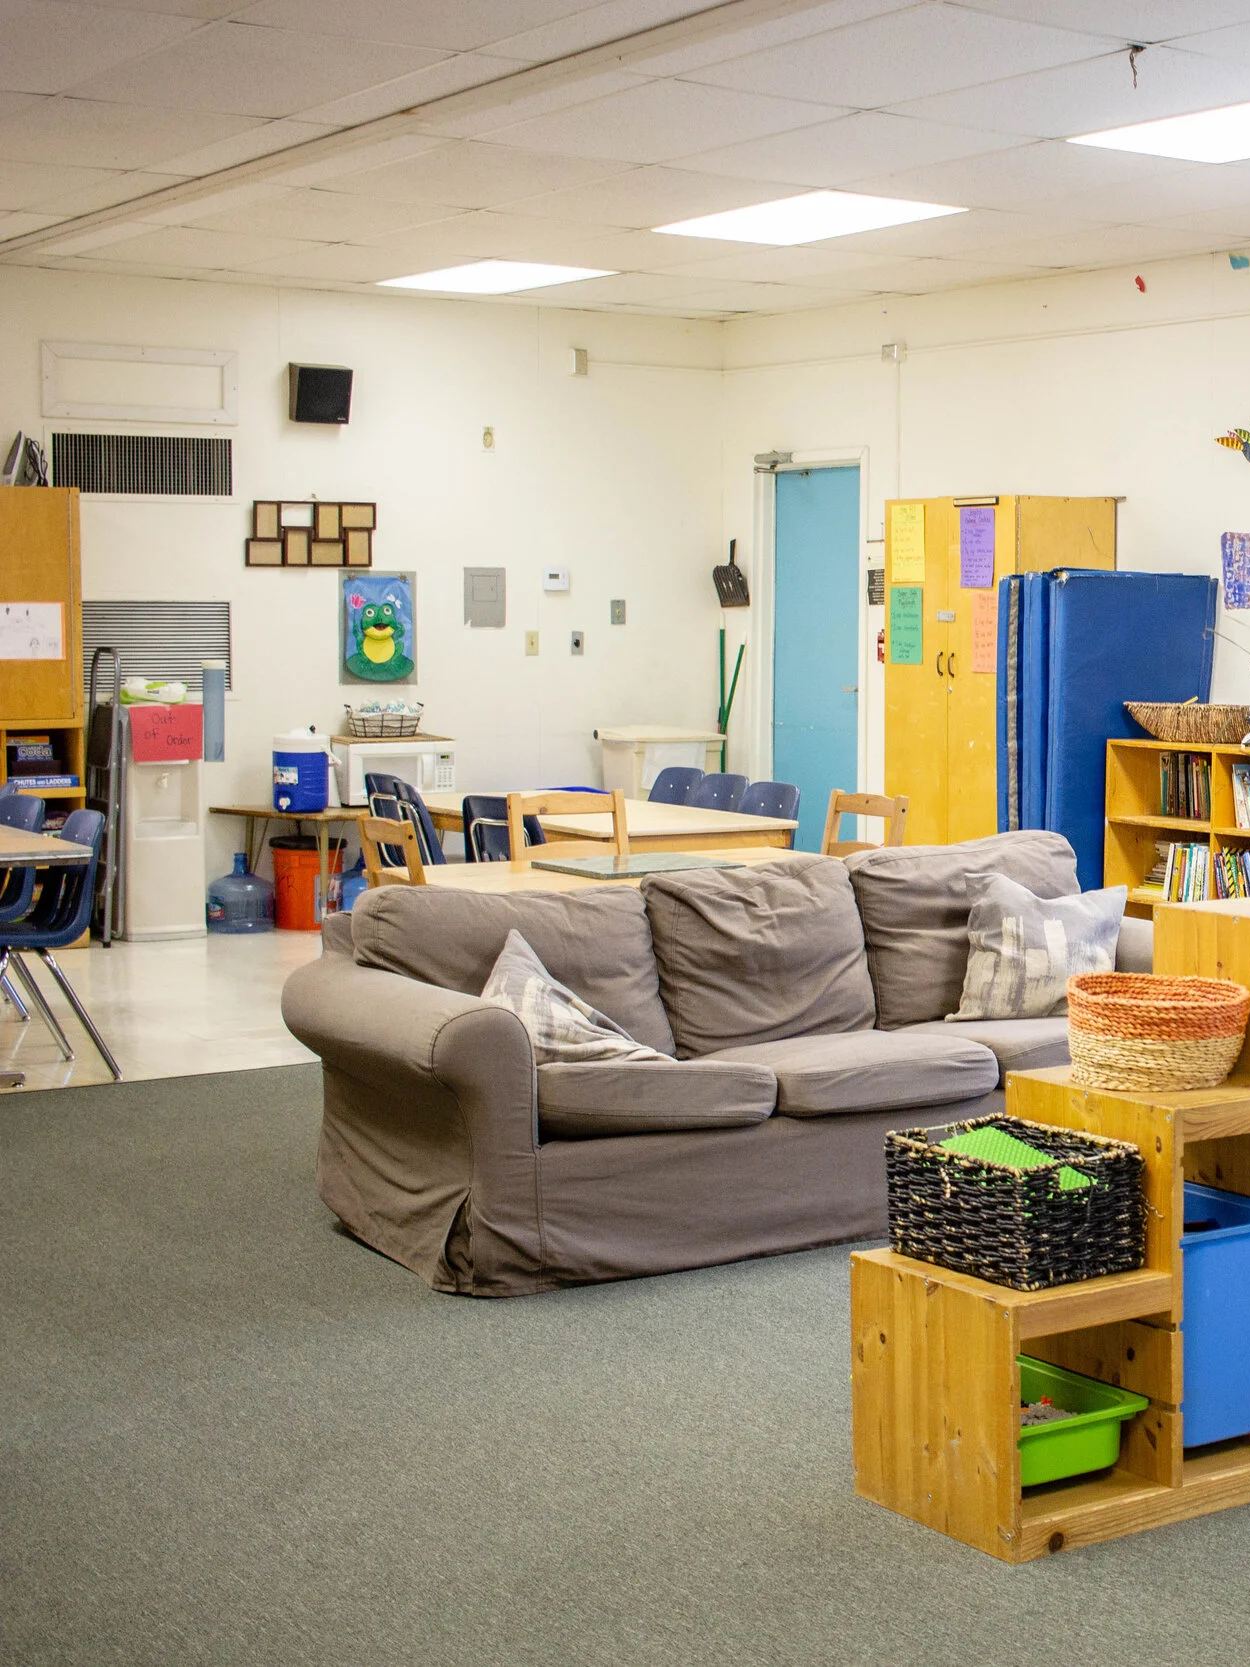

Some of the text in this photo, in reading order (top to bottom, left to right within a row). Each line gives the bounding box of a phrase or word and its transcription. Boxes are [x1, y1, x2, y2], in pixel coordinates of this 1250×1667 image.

[151, 712, 176, 724] Out
[144, 728, 160, 739] of
[166, 733, 193, 746] Order
[46, 777, 72, 785] LADDERS
